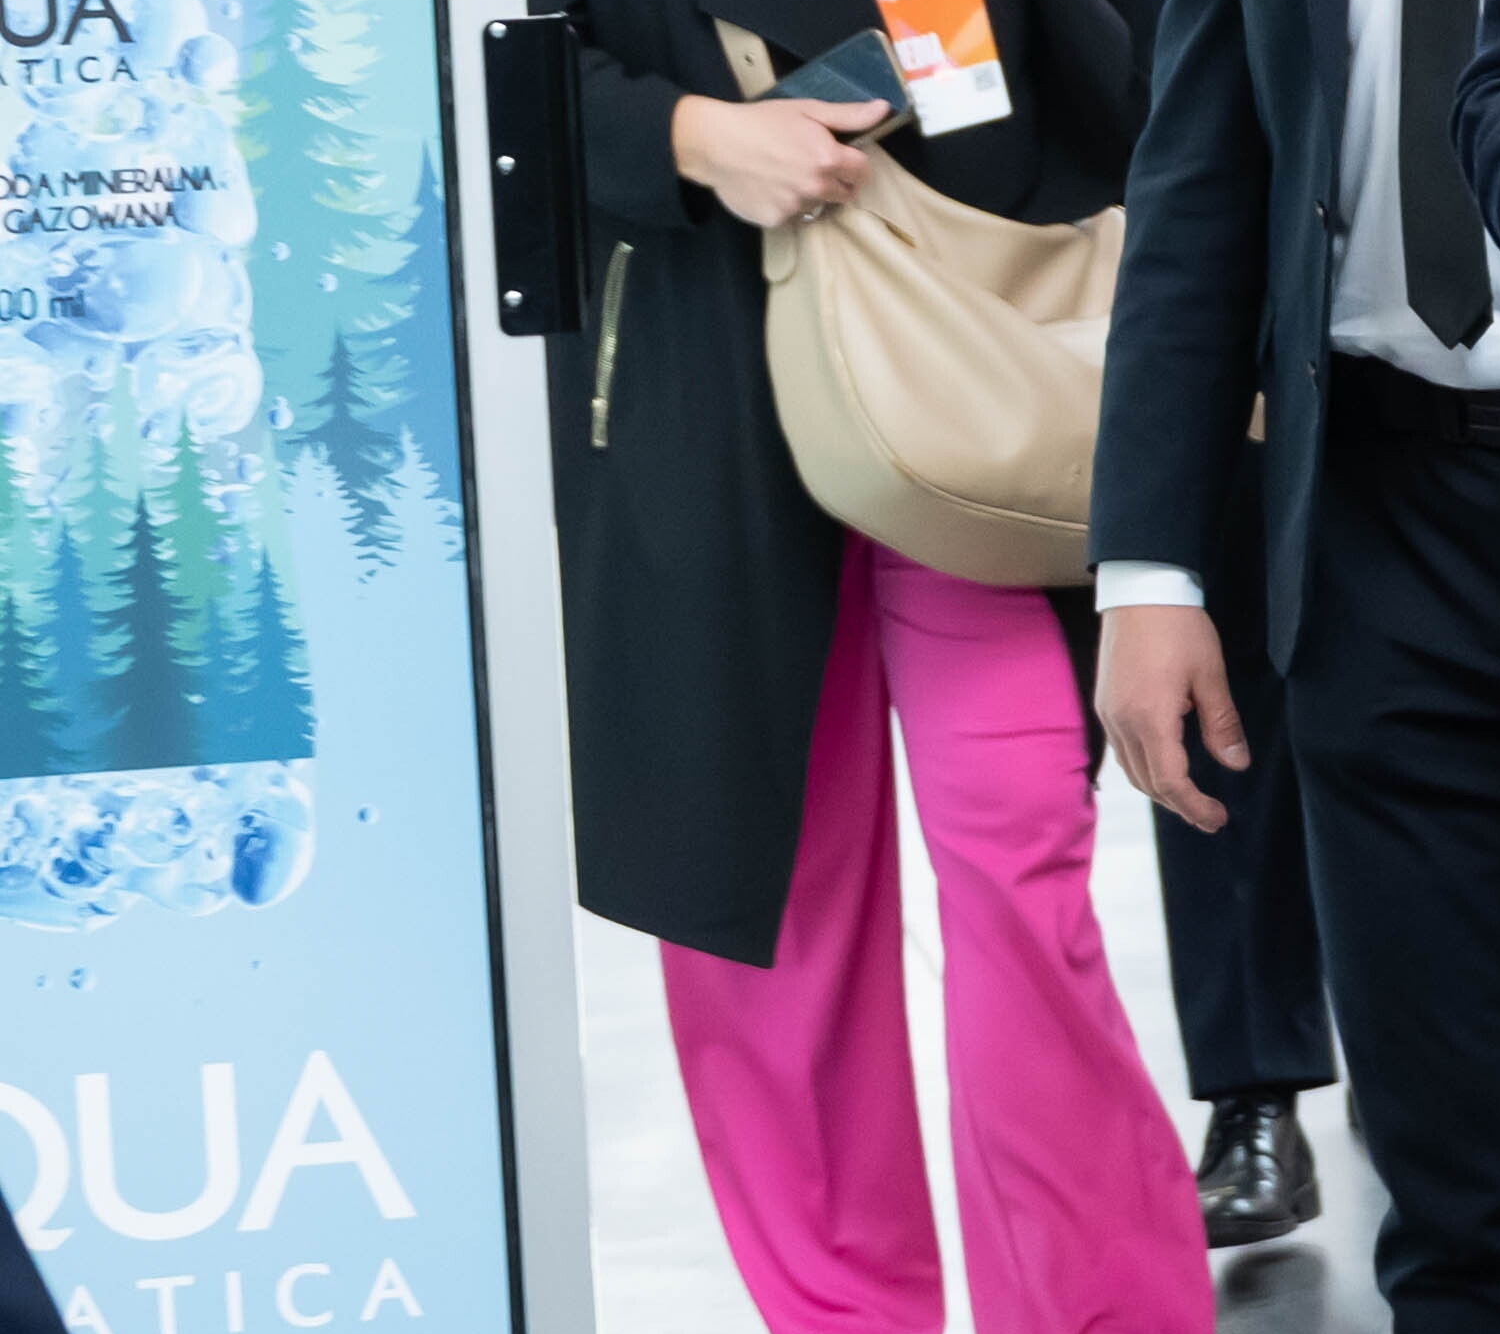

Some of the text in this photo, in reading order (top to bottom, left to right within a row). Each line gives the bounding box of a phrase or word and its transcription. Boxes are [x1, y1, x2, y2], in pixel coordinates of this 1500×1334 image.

[0, 56, 138, 86] TICA
[63, 165, 218, 198] MINERALNA
[3, 201, 181, 234] GAZOWANA
